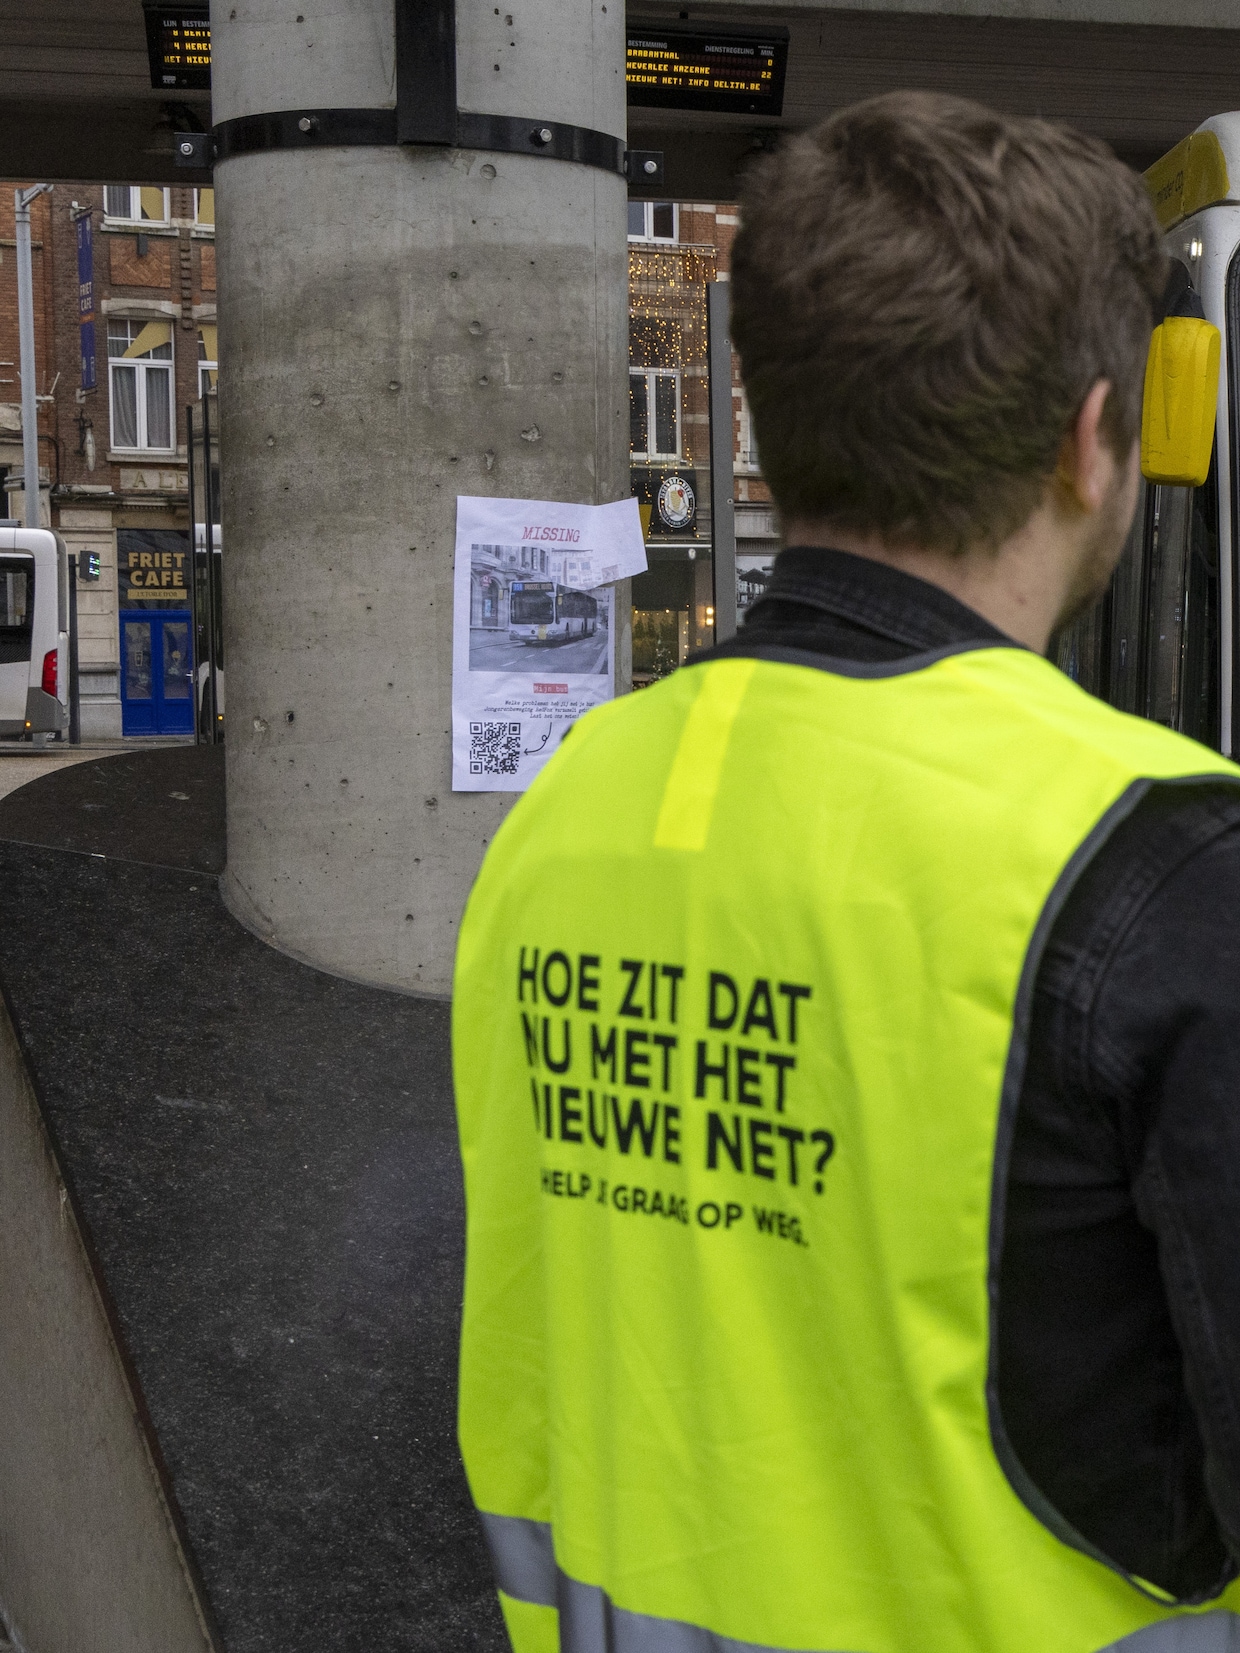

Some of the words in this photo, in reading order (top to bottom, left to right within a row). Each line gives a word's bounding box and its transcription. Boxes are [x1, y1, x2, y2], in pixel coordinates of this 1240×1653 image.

[173, 42, 180, 50] 4
[627, 40, 667, 49] BESTEMMING
[705, 45, 754, 55] DIENSTREGELING
[627, 49, 679, 60] BRABANTHAL
[186, 56, 212, 64] NIEU
[627, 62, 669, 72] HEVERLEE
[673, 65, 711, 75] KAZERNE
[761, 71, 772, 79] 22
[626, 74, 658, 84] NIEUWE
[662, 76, 682, 85] NET!
[688, 78, 709, 87] INFO
[714, 80, 761, 91] DELIJN.BE
[80, 281, 92, 297] FRIET
[521, 526, 581, 543] MISSING
[128, 552, 186, 568] FRIET
[130, 570, 184, 587] CAFE
[534, 684, 552, 694] Mijn
[555, 685, 568, 693] bus
[517, 946, 601, 1012] HOE
[617, 957, 686, 1026] ZIT
[706, 970, 813, 1046] DAT
[521, 1011, 573, 1075] NU
[590, 1021, 679, 1094] MET
[694, 1039, 797, 1115] HET
[705, 1110, 836, 1197] NET?
[542, 1169, 592, 1199] HELP
[696, 1201, 744, 1230] OP
